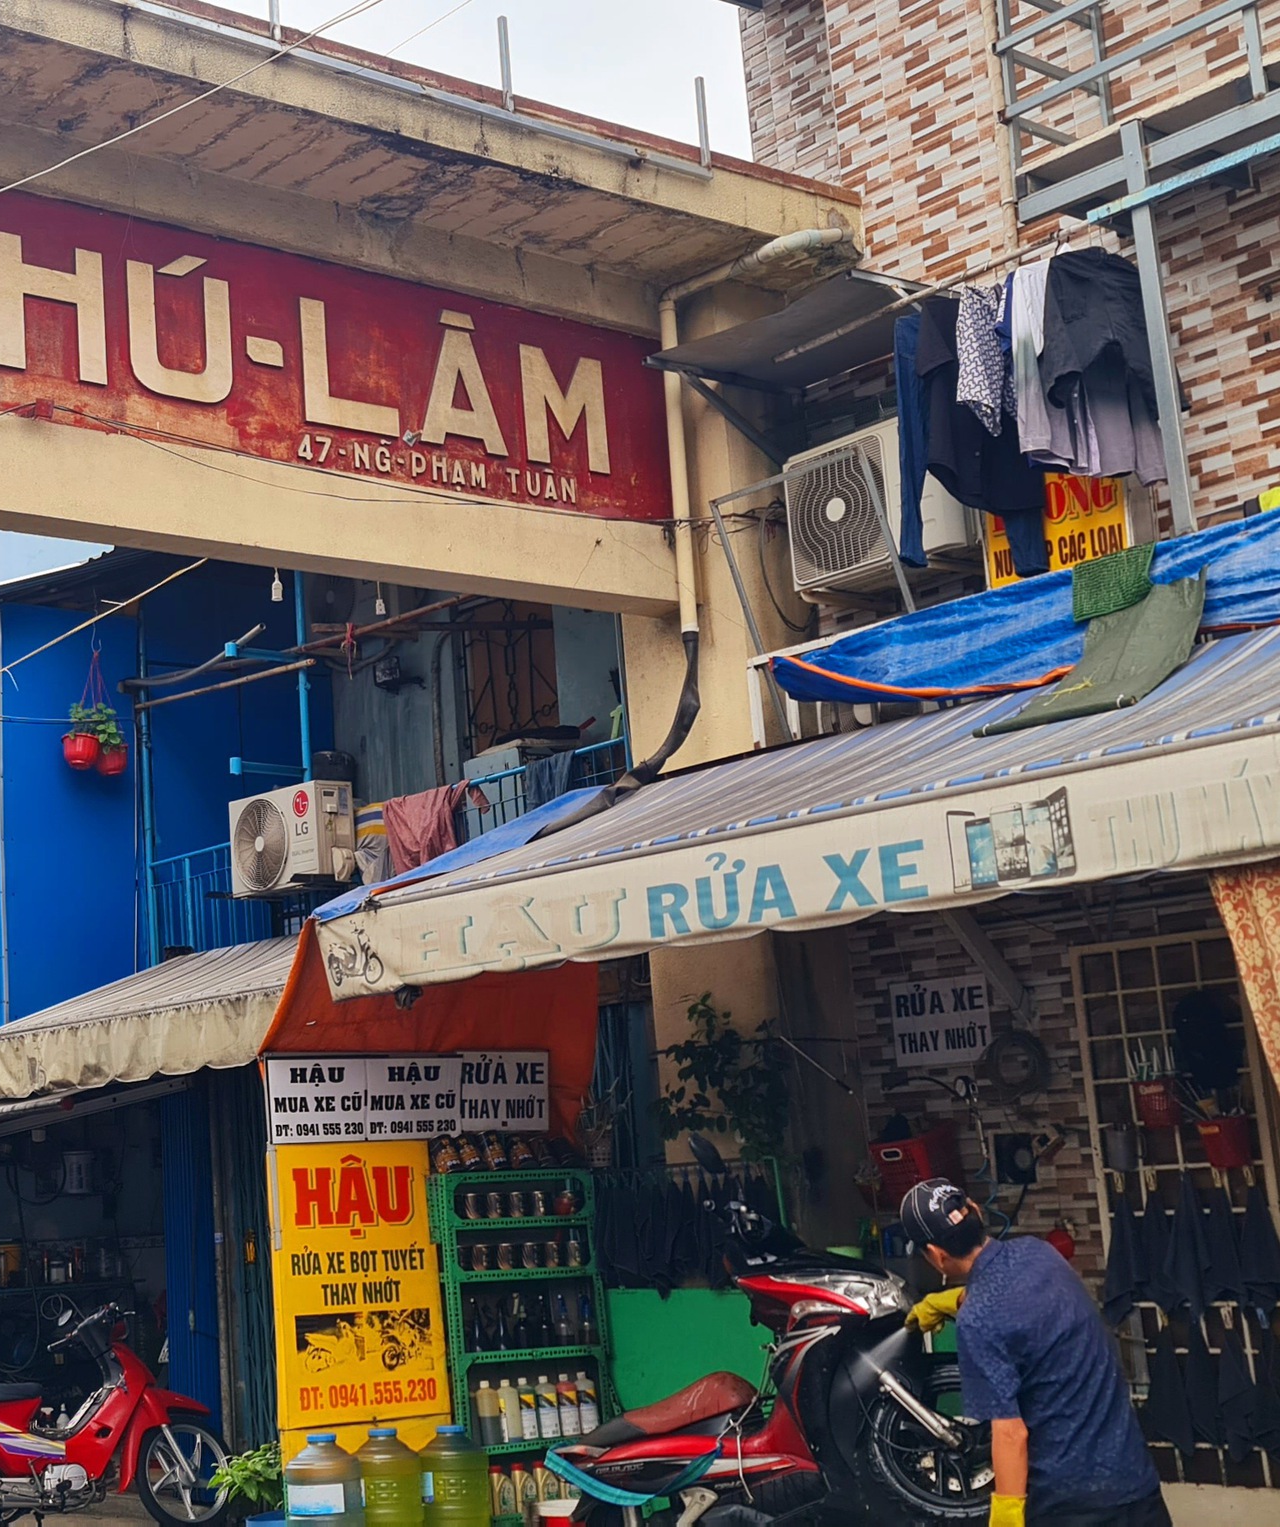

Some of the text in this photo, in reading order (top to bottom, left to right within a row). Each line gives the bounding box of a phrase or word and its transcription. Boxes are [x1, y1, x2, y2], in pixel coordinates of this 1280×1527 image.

[1057, 529, 1087, 566] CÁC
[295, 821, 309, 837] LG
[647, 851, 797, 938] RỬA
[822, 838, 930, 912] XE
[895, 983, 984, 1018] RỬA XE
[898, 1021, 988, 1054] THAY NHỚT
[290, 1061, 441, 1088] HẬU HẬU
[515, 1061, 545, 1085] XE
[274, 1091, 362, 1113] MUA XE CŨ
[370, 1089, 456, 1112] MUA XE CŨ
[460, 1089, 546, 1119] THAY NHỚT
[275, 1121, 364, 1137] ĐT: 0941 555 230
[370, 1118, 457, 1135] ĐT: 0941 555 230
[291, 1153, 413, 1239] HẬU
[291, 1240, 425, 1278] RỬA XE BỌT TUYẾT
[321, 1275, 401, 1307] THAY NHỚT
[299, 1377, 437, 1411] ĐT: 0941.555.230
